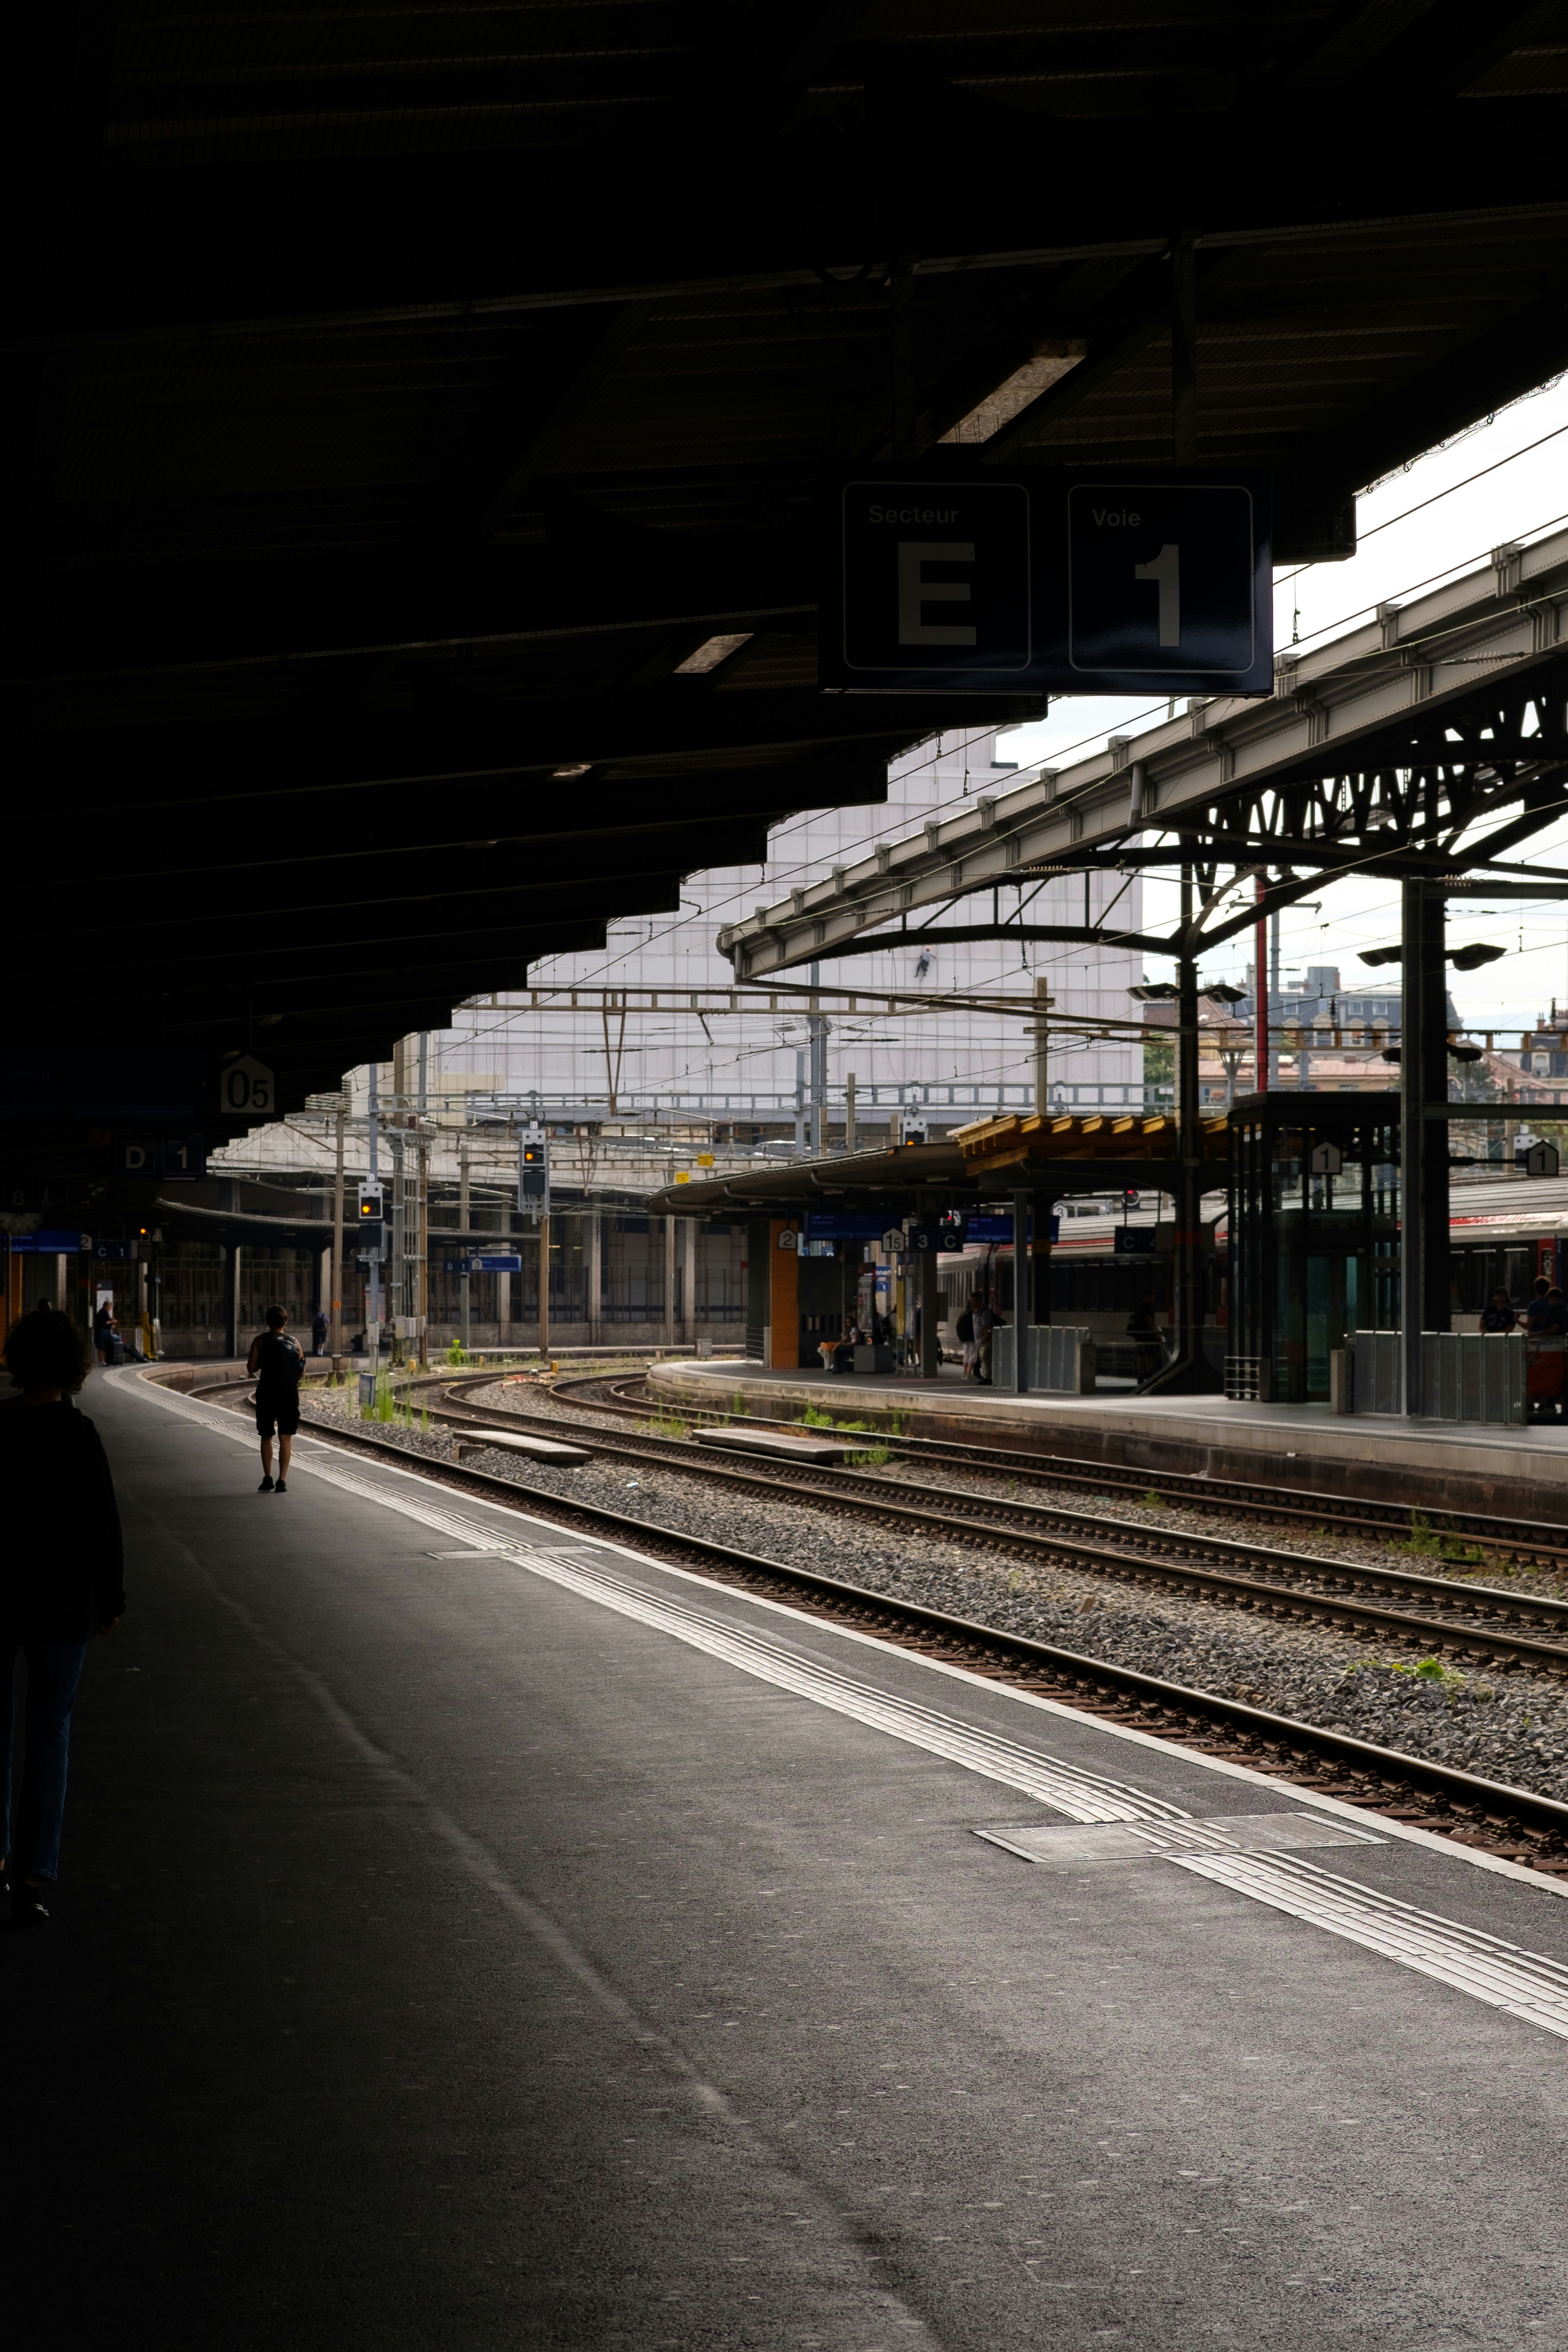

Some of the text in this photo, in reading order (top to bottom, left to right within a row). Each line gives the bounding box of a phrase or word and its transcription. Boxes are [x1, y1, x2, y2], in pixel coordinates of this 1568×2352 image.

[868, 505, 959, 524] Secteur
[1091, 509, 1141, 527] Voie
[898, 541, 977, 646] E
[1134, 544, 1180, 647] 1
[227, 1069, 268, 1108] 05
[125, 1146, 145, 1169] D
[176, 1147, 187, 1169] 1
[1321, 1148, 1329, 1170] 1
[1537, 1149, 1545, 1171] 1
[12, 1190, 25, 1206] 8
[783, 1234, 792, 1246] 2
[886, 1233, 901, 1250] 15
[918, 1235, 928, 1248] 3
[944, 1235, 956, 1248] C
[1122, 1235, 1135, 1249] C
[98, 1247, 107, 1257] C
[118, 1247, 124, 1257] 1
[473, 1260, 481, 1268] 3
